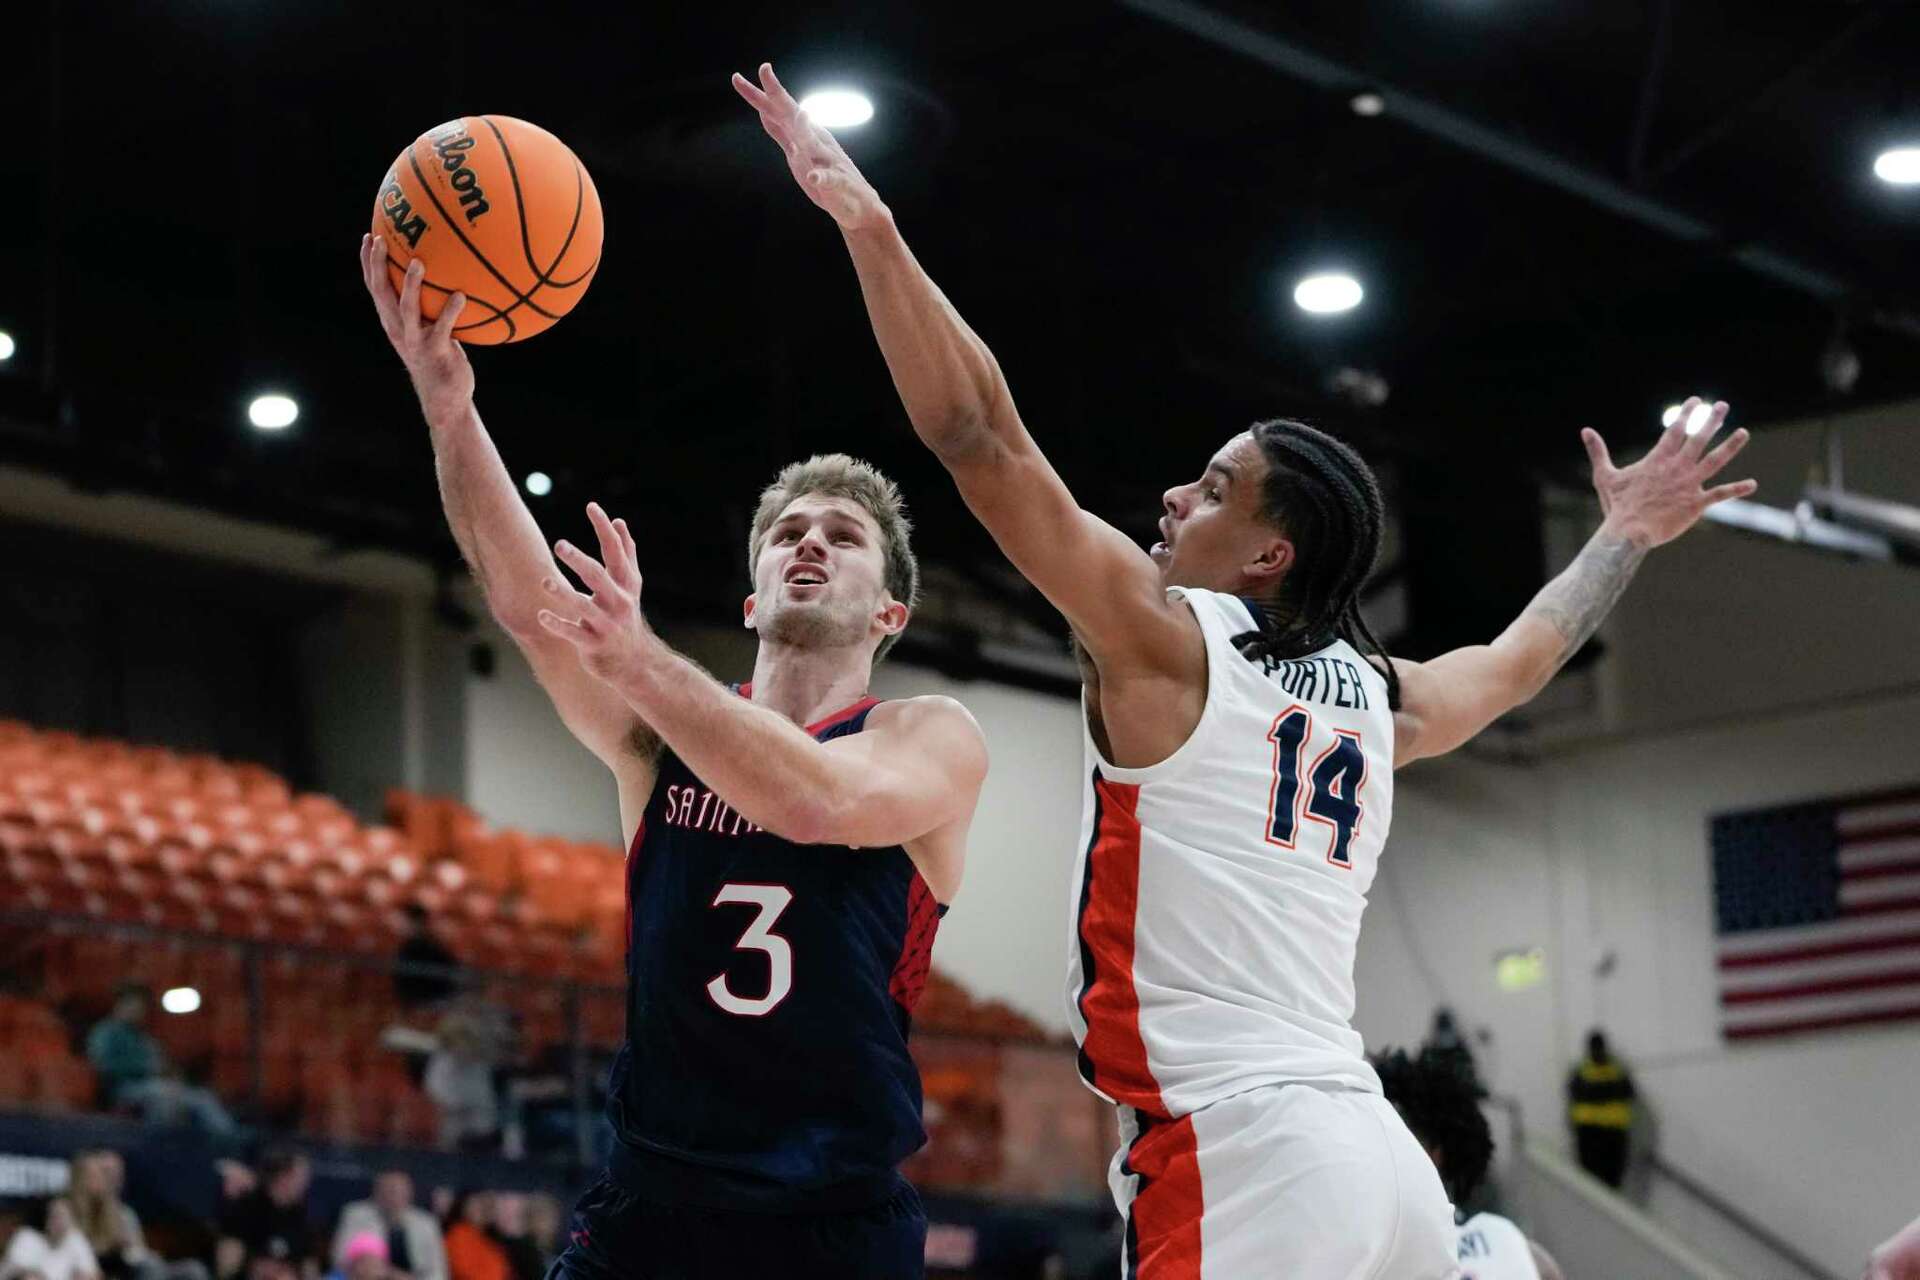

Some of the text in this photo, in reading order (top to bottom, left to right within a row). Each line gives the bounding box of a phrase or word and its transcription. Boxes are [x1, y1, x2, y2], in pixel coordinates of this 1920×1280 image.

[1263, 654, 1369, 710] PORTER
[1266, 704, 1369, 869] 14
[706, 883, 794, 1016] 3
